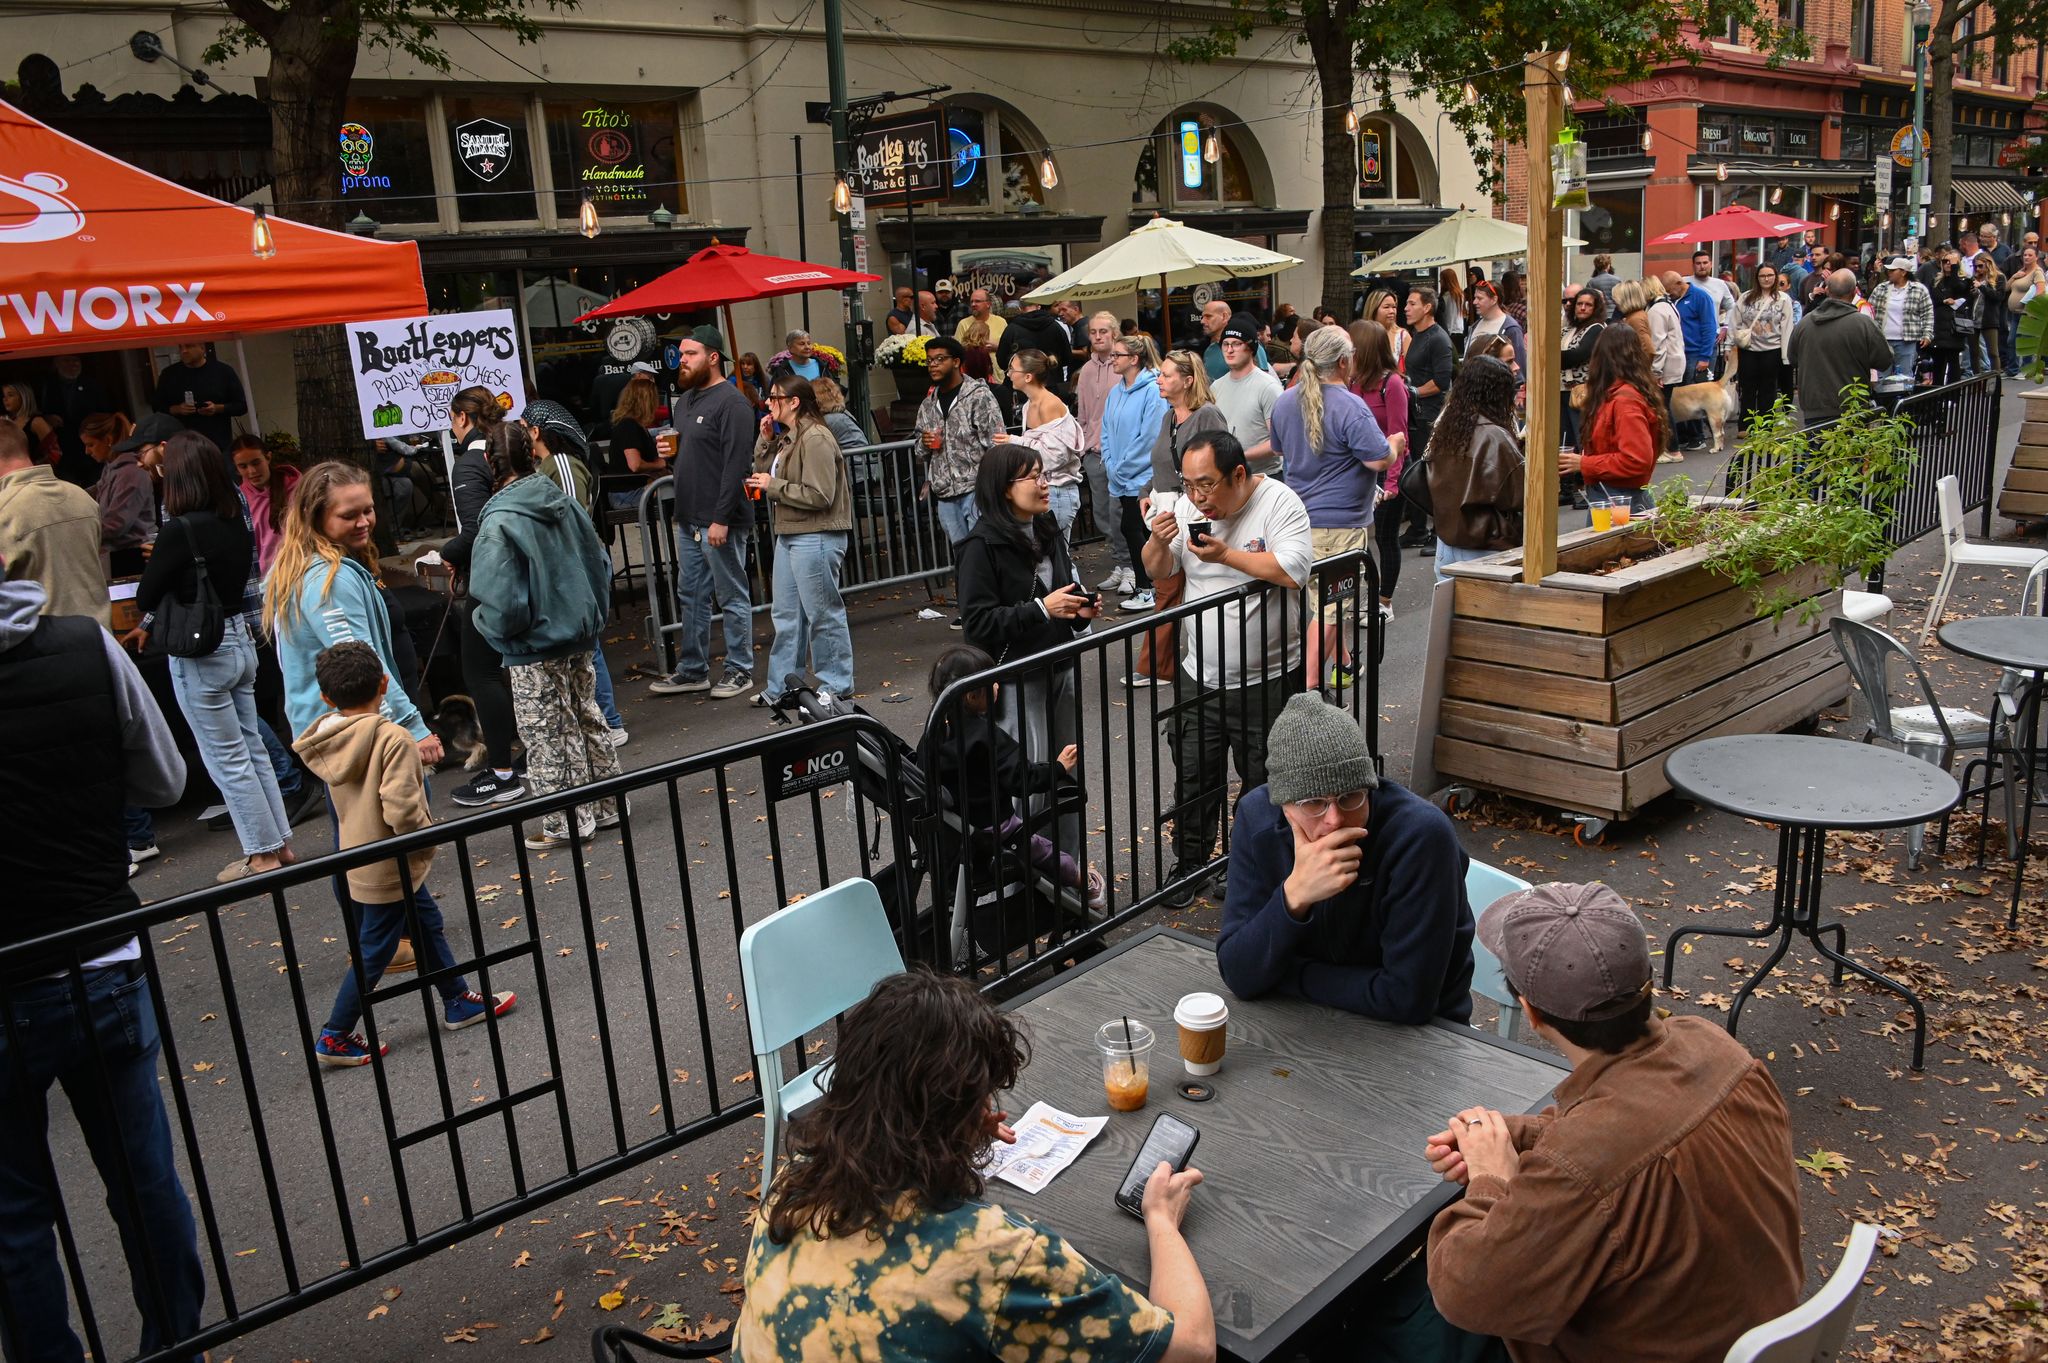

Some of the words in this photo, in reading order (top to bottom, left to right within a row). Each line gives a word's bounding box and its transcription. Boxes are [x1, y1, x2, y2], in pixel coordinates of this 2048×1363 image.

[581, 107, 631, 128] Tito's
[460, 132, 509, 148] SAMUEL
[1702, 127, 1721, 140] FRESH
[1743, 129, 1770, 143] ORGANIC
[1790, 132, 1807, 145] LOCAL
[465, 145, 507, 159] ADAMS
[857, 133, 928, 185] Bootleger's
[581, 165, 645, 181] Handmade
[595, 185, 635, 194] VODKA
[872, 179, 888, 191] Bar
[897, 175, 919, 187] Gill
[604, 365, 625, 375] Bar
[372, 368, 421, 401] PHILLY
[464, 364, 512, 388] CHEESE
[476, 783, 497, 794] HOKA
